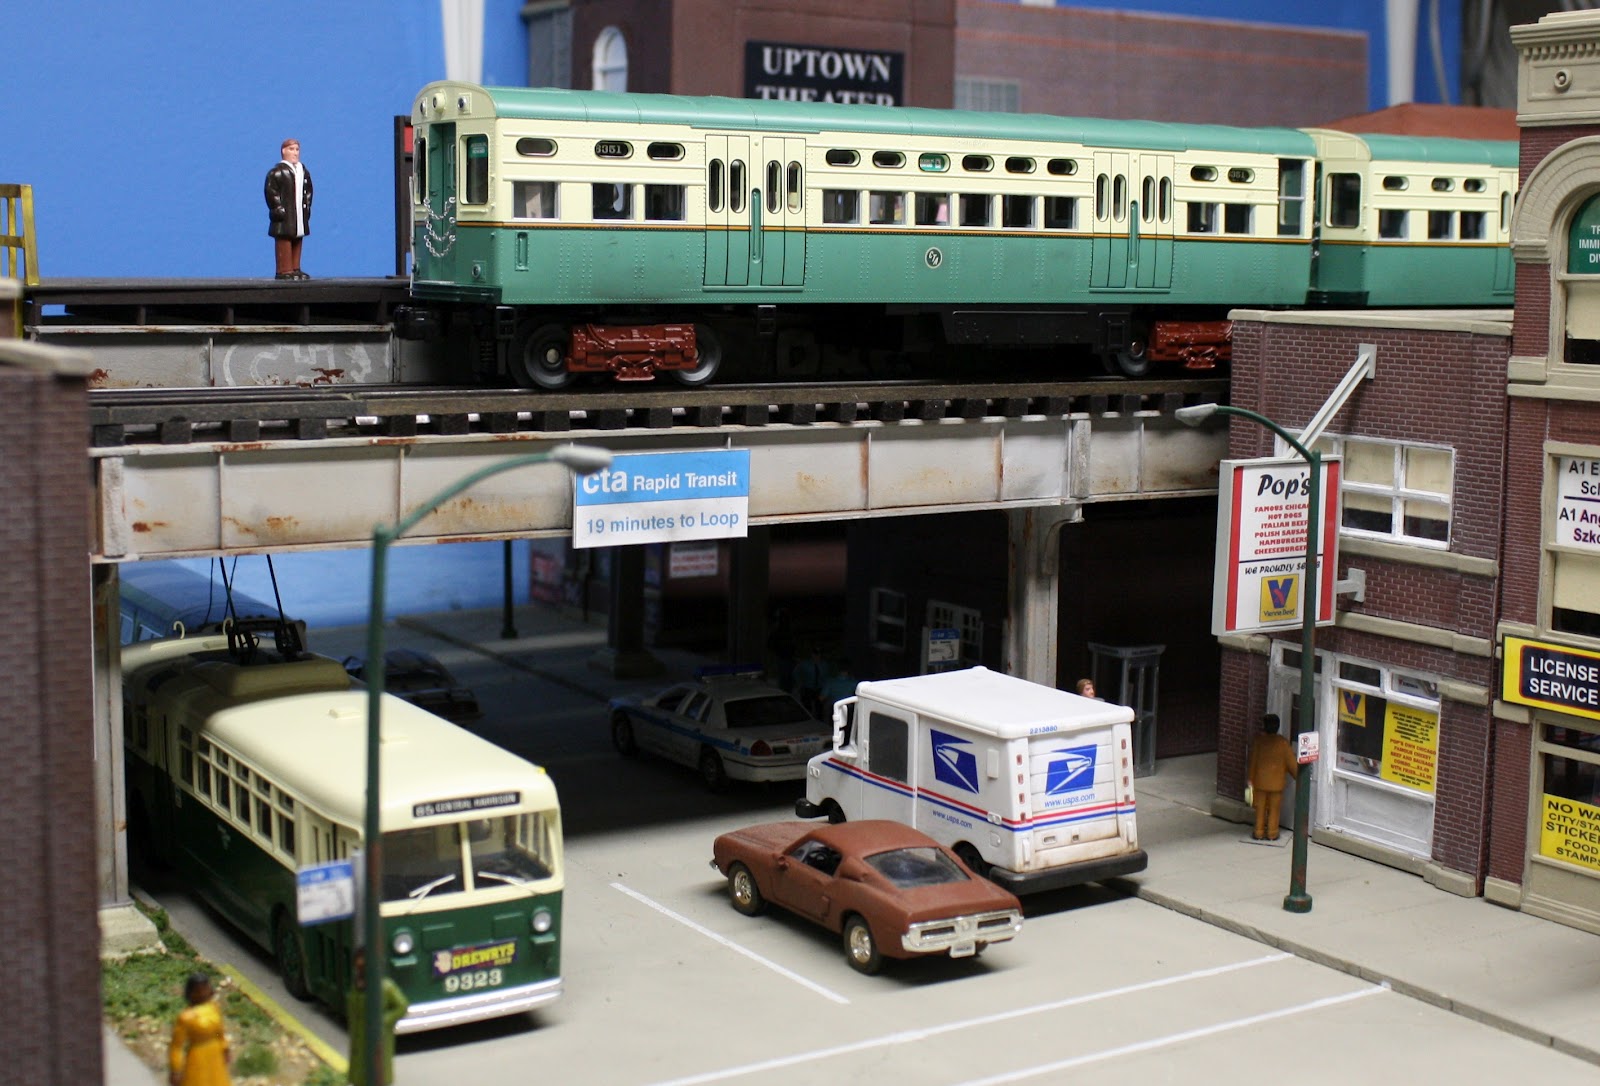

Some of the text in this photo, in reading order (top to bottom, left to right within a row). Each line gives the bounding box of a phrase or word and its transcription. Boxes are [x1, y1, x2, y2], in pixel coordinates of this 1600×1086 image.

[762, 46, 891, 82] UPTOWN
[928, 250, 939, 266] CTA
[1589, 253, 1600, 263] DI
[1568, 460, 1585, 475] A1
[582, 469, 737, 494] cta Rapid Transit
[1257, 471, 1310, 500] Pop's
[1254, 503, 1310, 513] FAMOUS CHICA
[587, 511, 739, 534] 19 minutes to Loop
[1261, 521, 1290, 529] ITALIAN
[1559, 507, 1600, 528] A1 An
[1254, 528, 1309, 538] POLISH SAUSA
[1260, 563, 1294, 573] PROUDLY
[1530, 656, 1599, 684] LICENSE
[1529, 677, 1599, 705] SERVICE
[1044, 792, 1095, 808] www.usps.com
[1547, 800, 1573, 814] NO
[932, 809, 973, 829] www.usps.com
[1545, 821, 1600, 845] STICKE
[1564, 838, 1599, 855] FOOD
[445, 968, 503, 992] 9323
